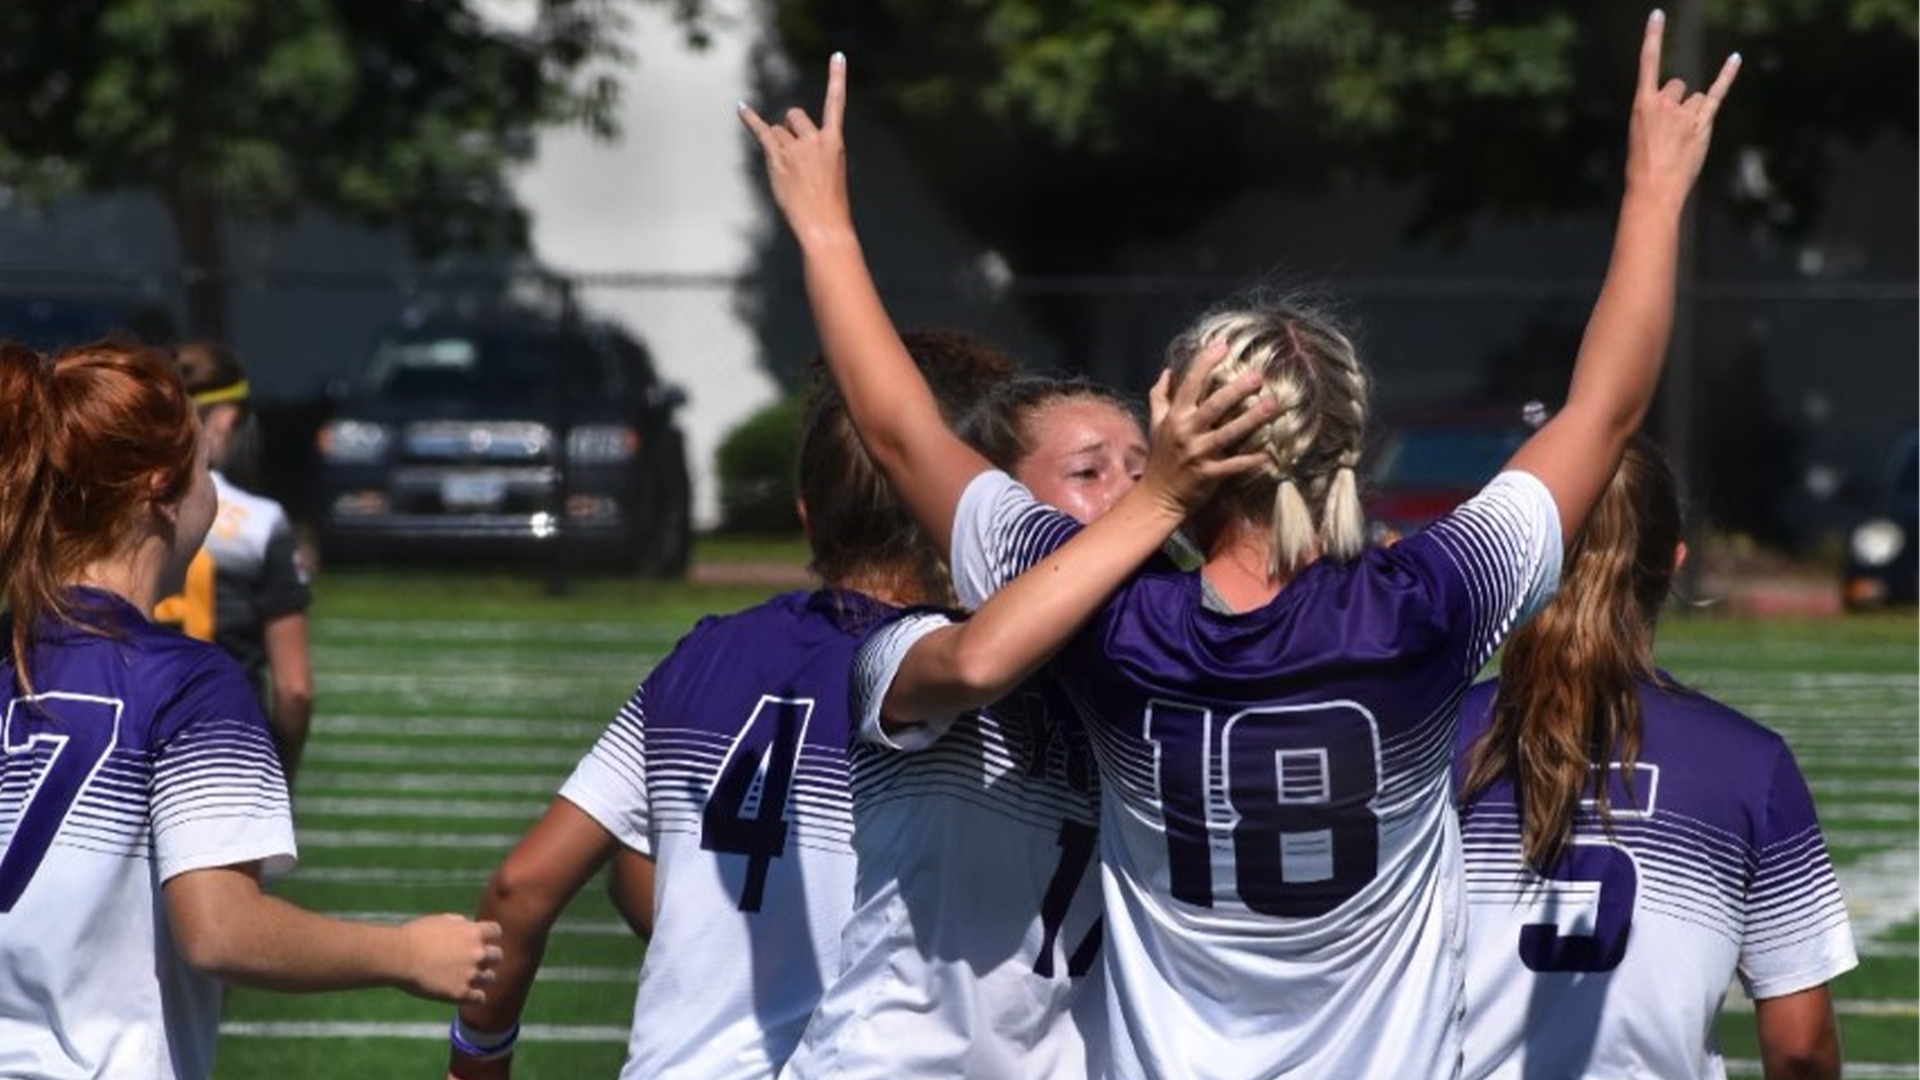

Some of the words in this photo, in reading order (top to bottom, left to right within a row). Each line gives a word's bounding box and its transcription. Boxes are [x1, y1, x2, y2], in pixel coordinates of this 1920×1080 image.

[0, 690, 124, 913] 7
[700, 695, 814, 912] 4
[1032, 817, 1102, 978] 1
[1144, 699, 1383, 918] 18
[1518, 762, 1661, 973] 5
